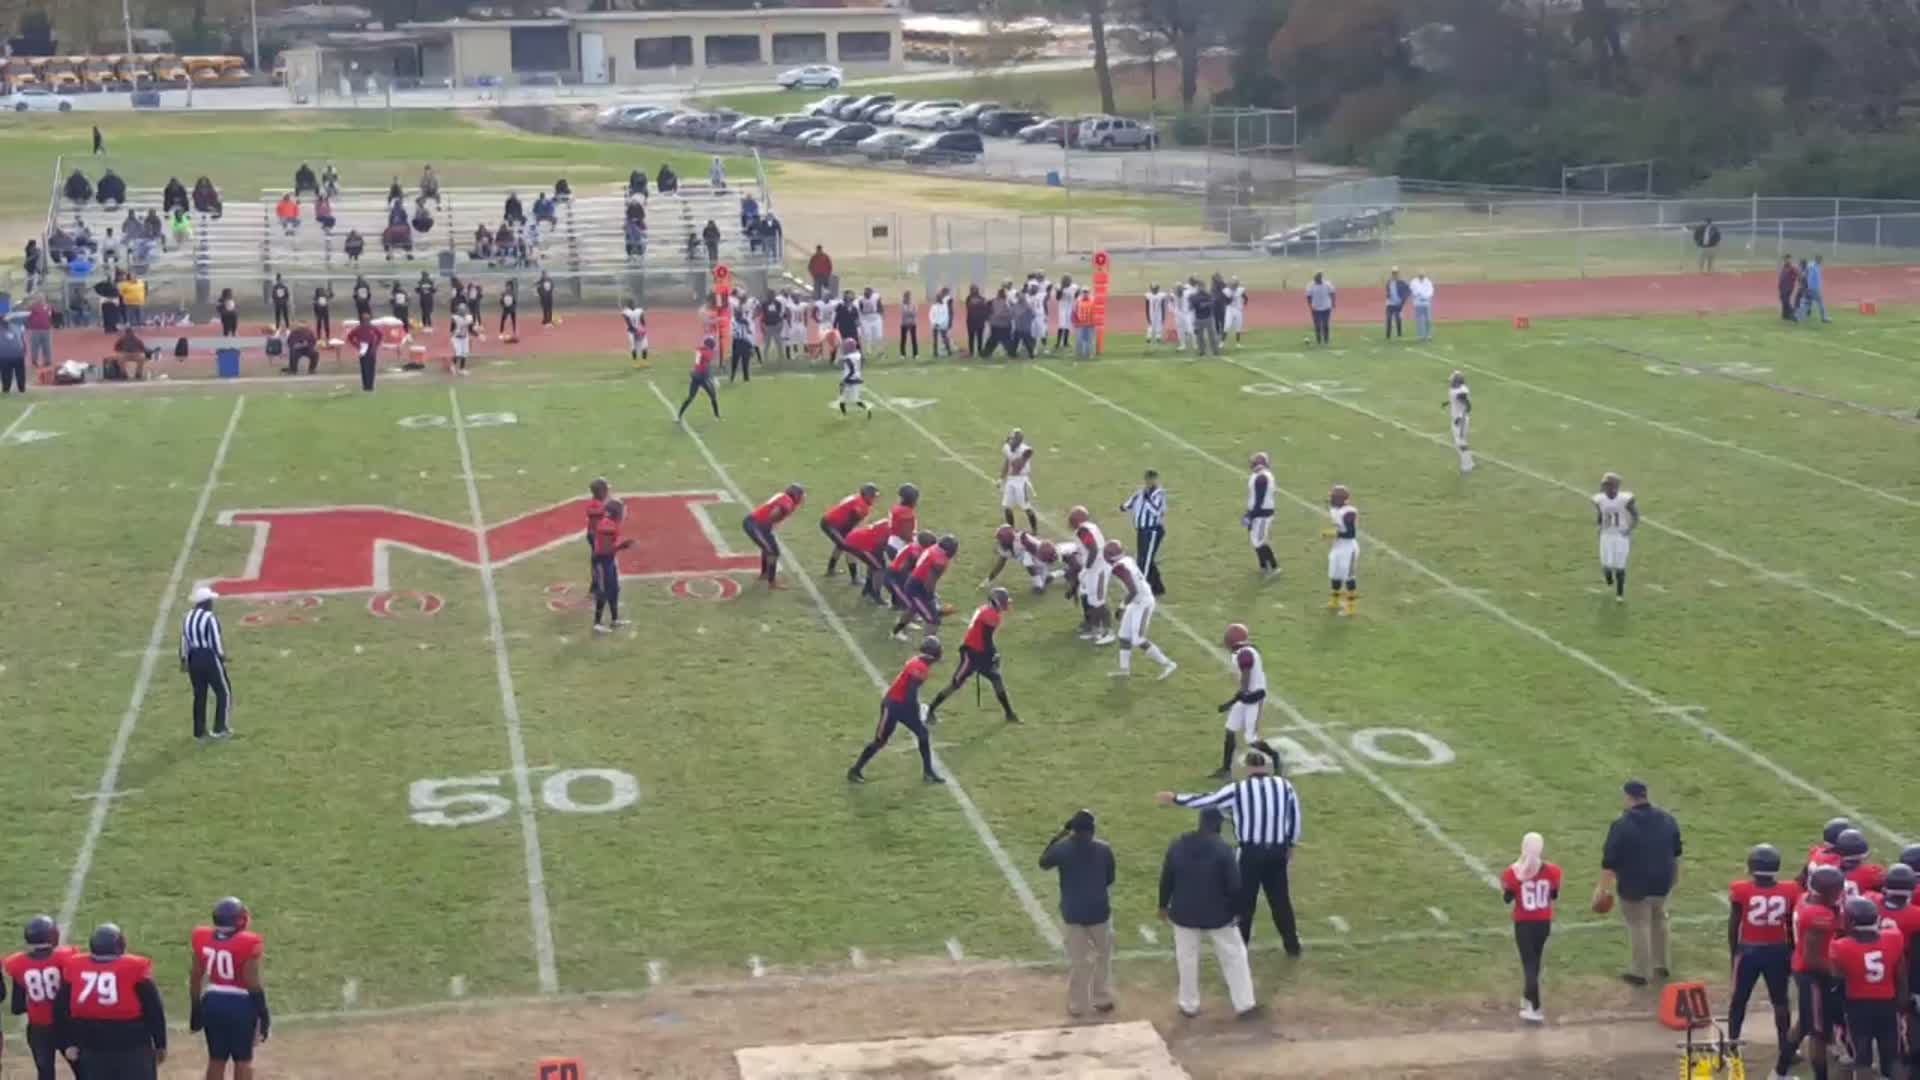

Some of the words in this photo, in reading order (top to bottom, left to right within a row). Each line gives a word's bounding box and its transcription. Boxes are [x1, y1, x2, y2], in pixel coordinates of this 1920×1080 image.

[204, 489, 774, 600] M
[409, 768, 640, 827] 50
[1521, 879, 1551, 911] 60
[1748, 896, 1787, 926] 22
[203, 947, 234, 980] 70
[1864, 950, 1885, 982] 5
[24, 967, 60, 1002] 88
[78, 971, 118, 1005] 79
[1674, 987, 1710, 1018] 40
